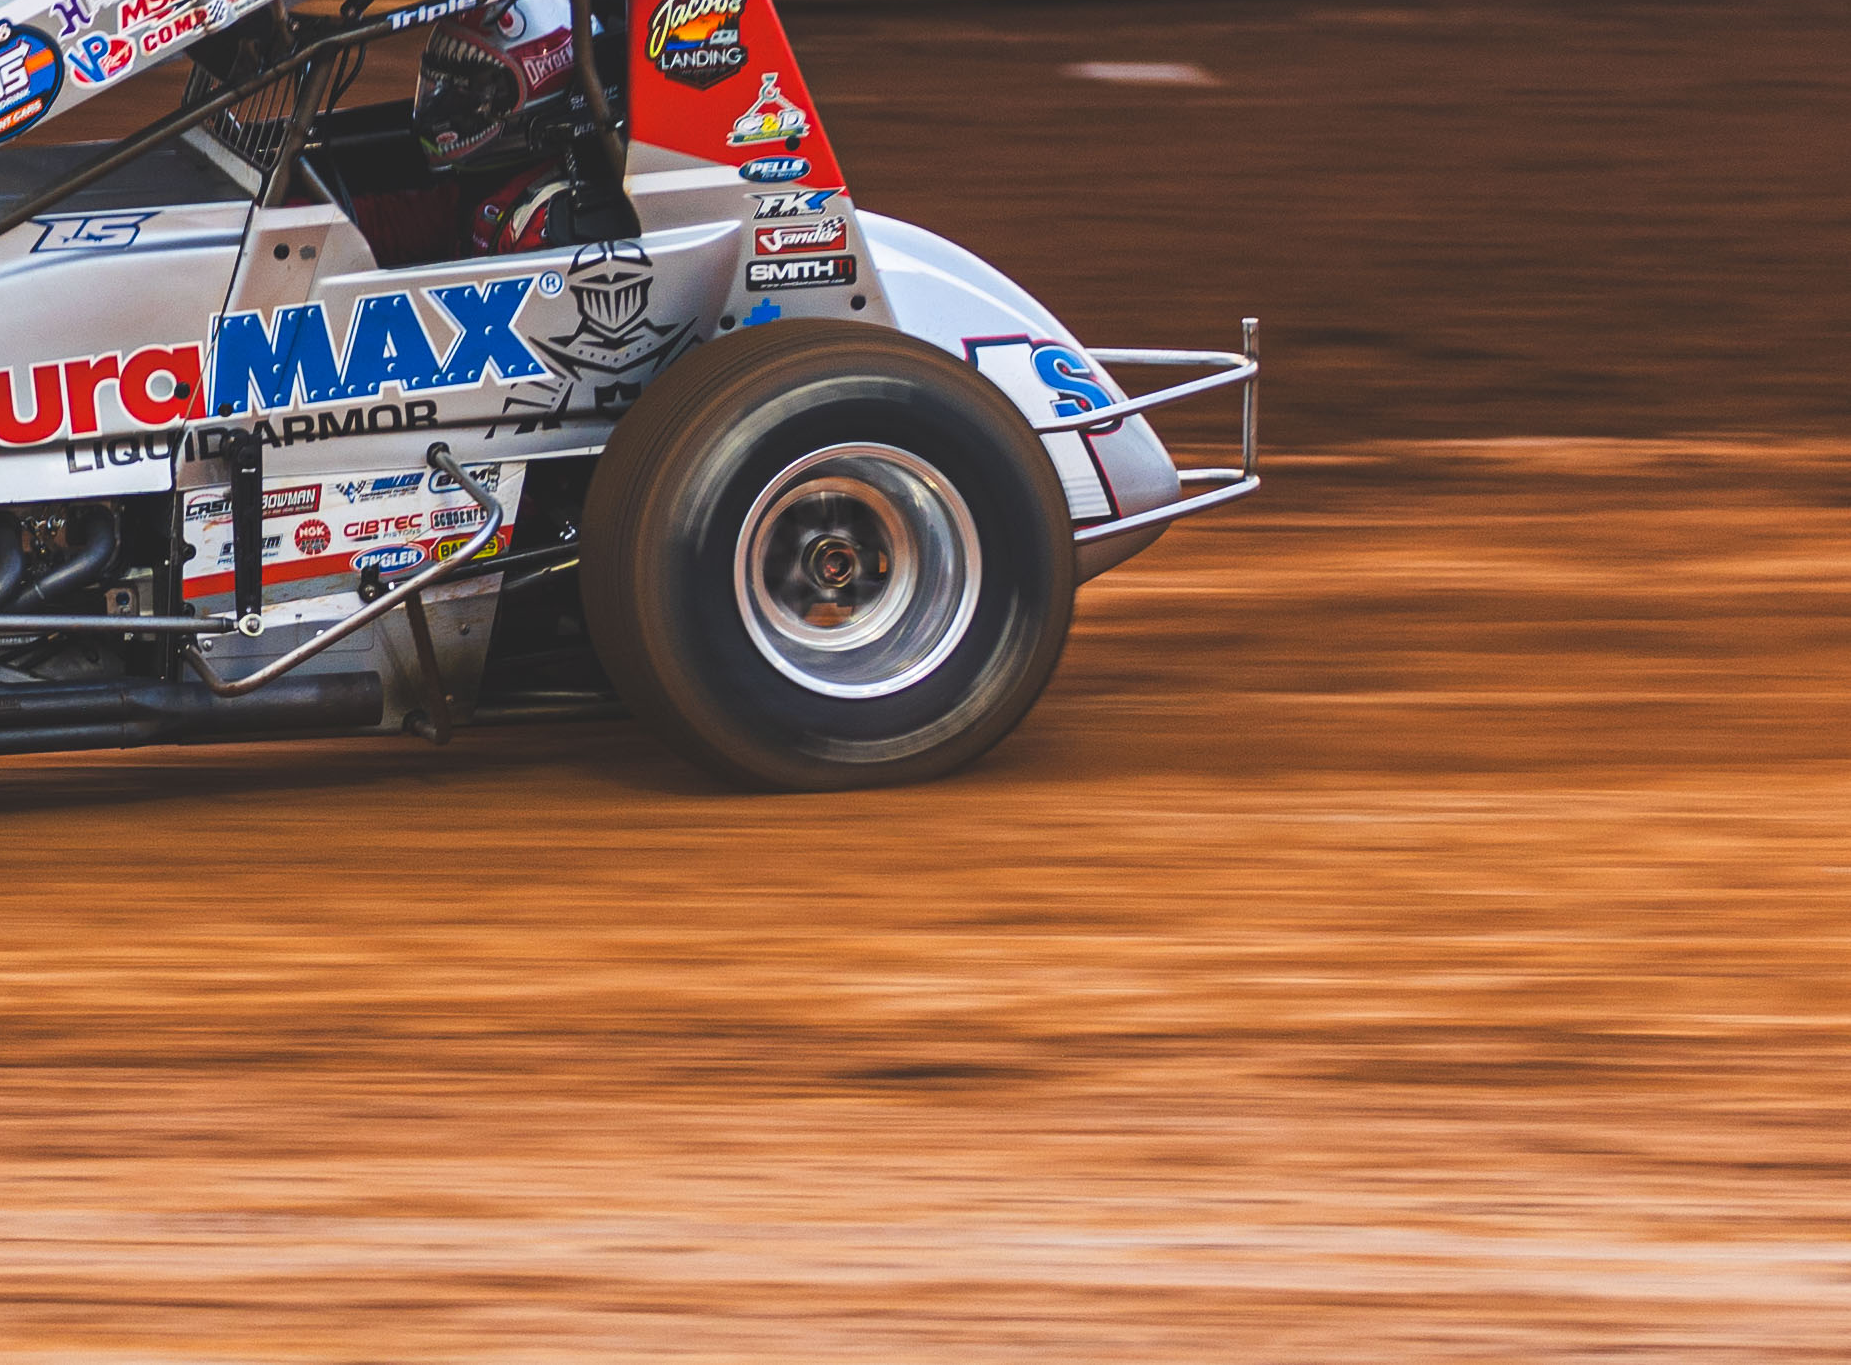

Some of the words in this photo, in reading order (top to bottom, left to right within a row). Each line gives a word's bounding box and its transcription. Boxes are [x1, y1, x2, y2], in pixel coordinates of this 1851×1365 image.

[68, 36, 109, 83] VP
[523, 40, 574, 85] DRYDEN
[661, 47, 742, 70] LANDING
[13, 99, 42, 121] CARS
[66, 426, 232, 474] LIQUID
[251, 399, 440, 451] ARMOR
[343, 513, 424, 538] GIBTEC
[433, 506, 487, 528] SCHOENFE
[300, 525, 325, 538] NGK
